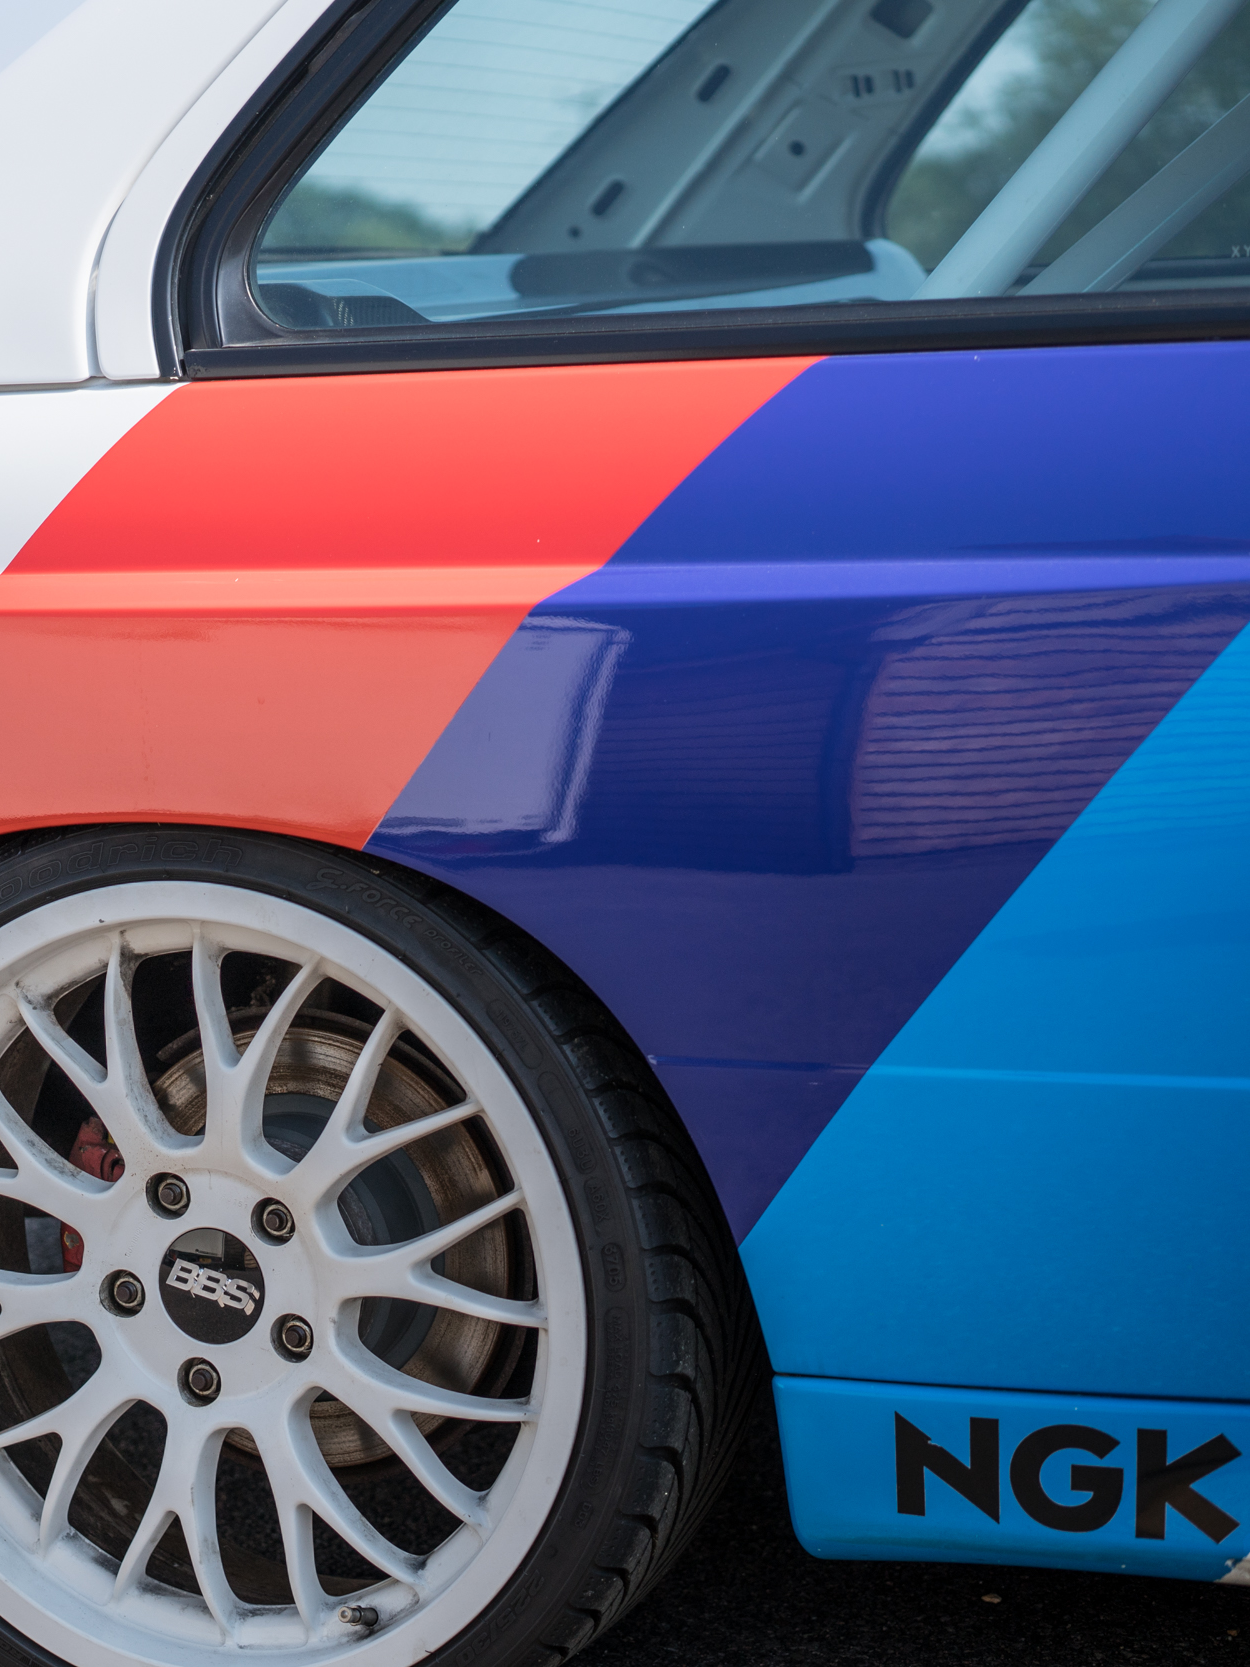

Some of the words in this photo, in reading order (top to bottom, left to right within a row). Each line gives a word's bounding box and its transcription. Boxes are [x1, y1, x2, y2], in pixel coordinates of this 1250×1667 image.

[166, 1258, 259, 1314] BBS
[614, 1346, 623, 1379] LOAD
[895, 1410, 1242, 1544] NGK
